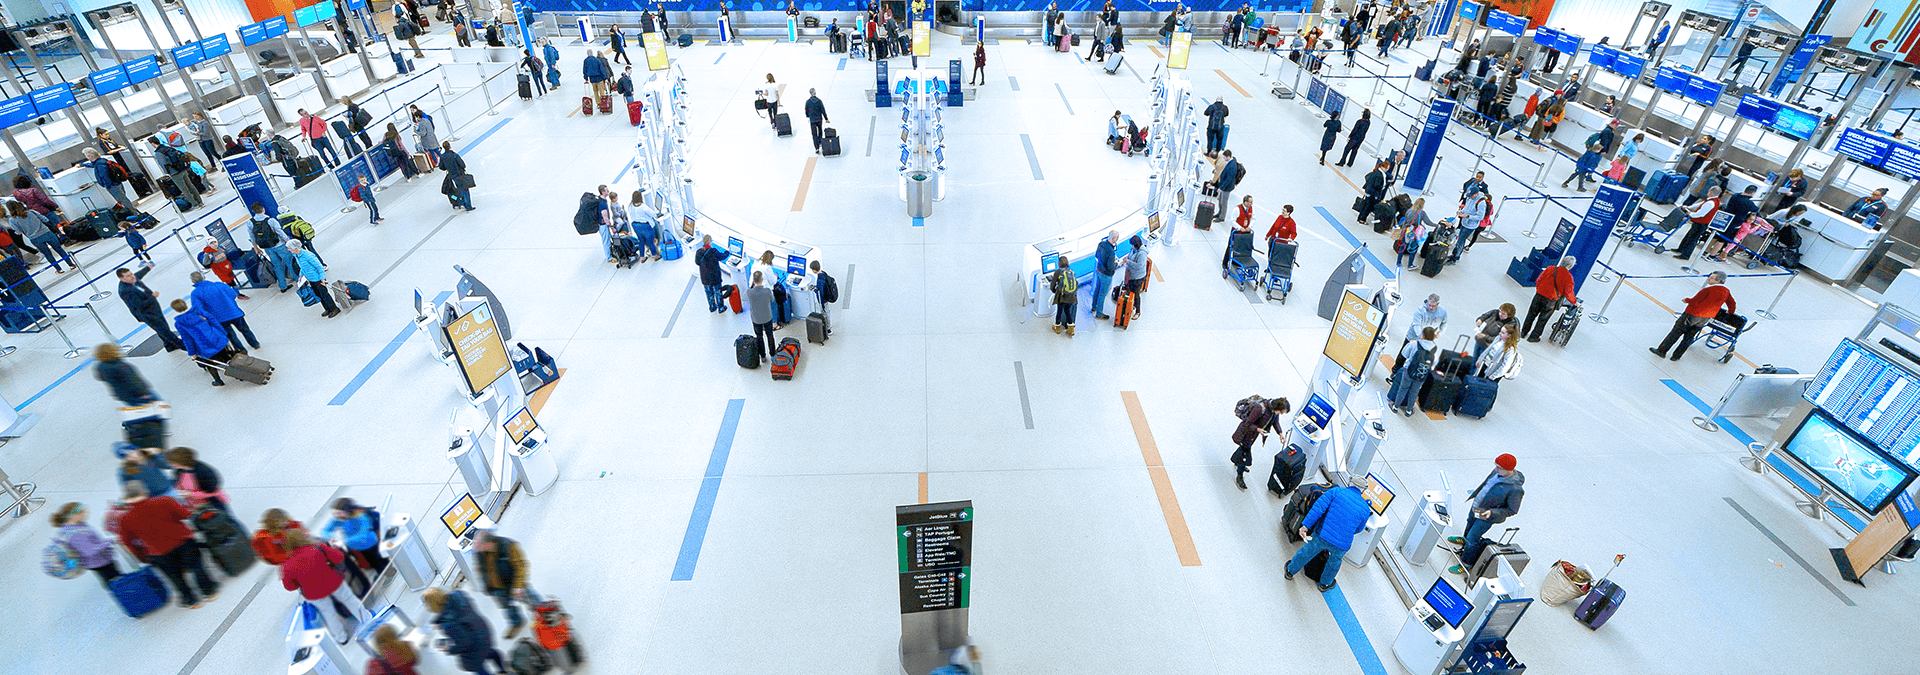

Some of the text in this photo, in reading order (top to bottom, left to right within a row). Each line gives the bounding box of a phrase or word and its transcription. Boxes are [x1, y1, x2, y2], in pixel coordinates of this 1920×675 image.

[1846, 131, 1889, 149] SPECIAL SERVICES
[1893, 146, 1914, 157] SPECIAL
[233, 170, 260, 181] ASSISTANCE
[1593, 203, 1615, 212] SERVICES
[1595, 198, 1614, 208] SPECIAL
[479, 310, 485, 318] 1
[1343, 309, 1364, 325] CHECK-IN
[1372, 312, 1377, 321] 1
[458, 328, 481, 346] CHECK-IN
[460, 327, 493, 352] TAG YOUR BAG
[513, 419, 531, 436] CHECK-IN
[1898, 496, 1908, 513] Directory
